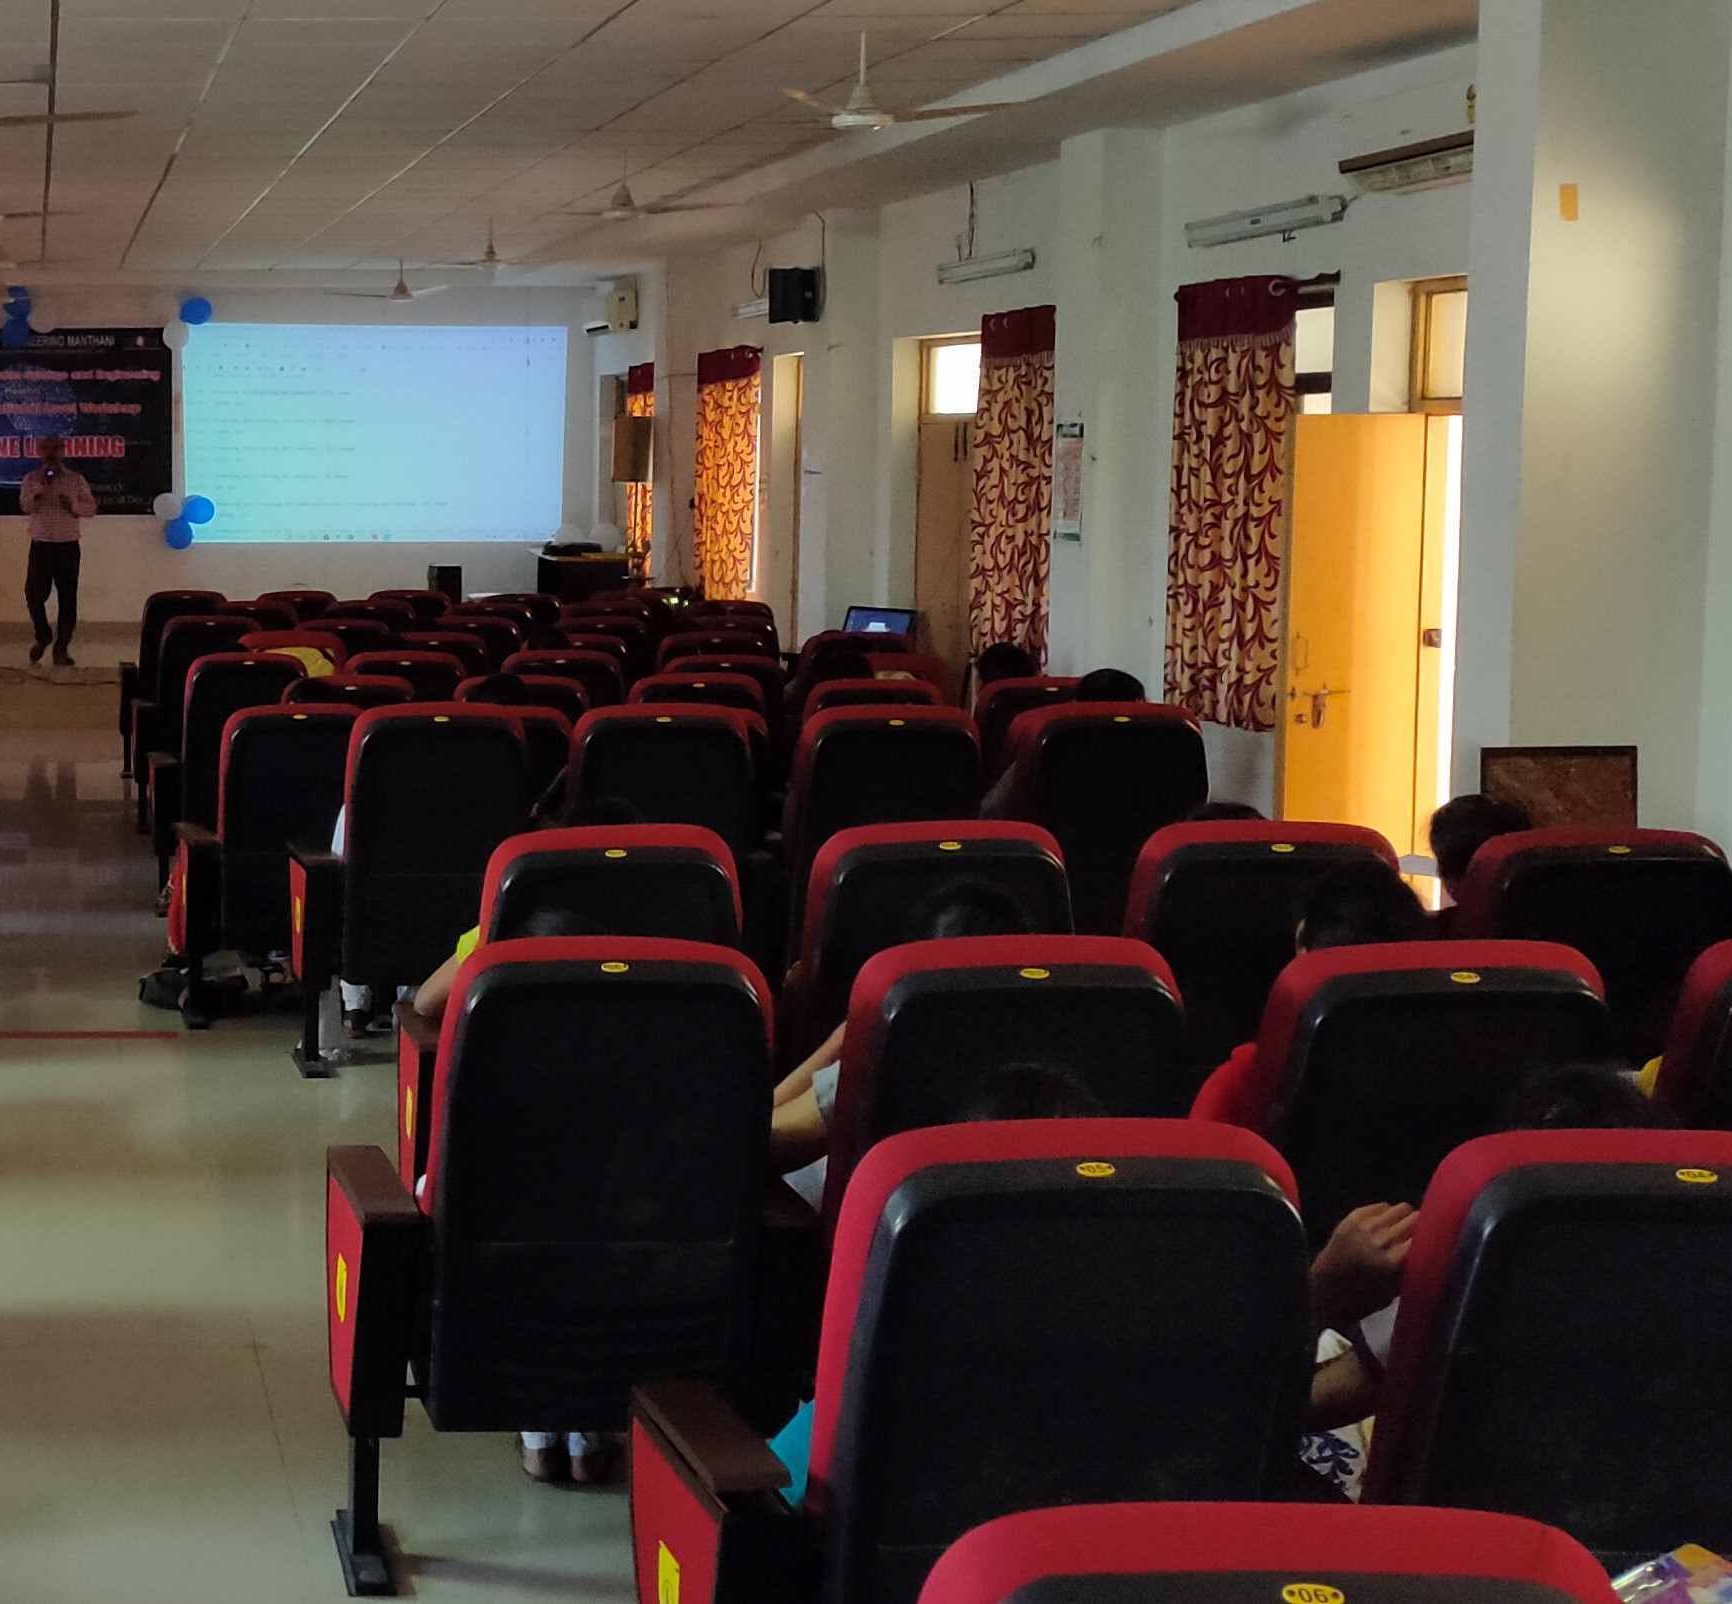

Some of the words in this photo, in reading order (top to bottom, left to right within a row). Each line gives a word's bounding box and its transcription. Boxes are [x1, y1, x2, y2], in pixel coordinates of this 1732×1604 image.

[67, 335, 115, 347] MANTHANI
[23, 435, 126, 458] LERNING
[1086, 1165, 1107, 1174] 05
[1298, 1587, 1329, 1604] 06
